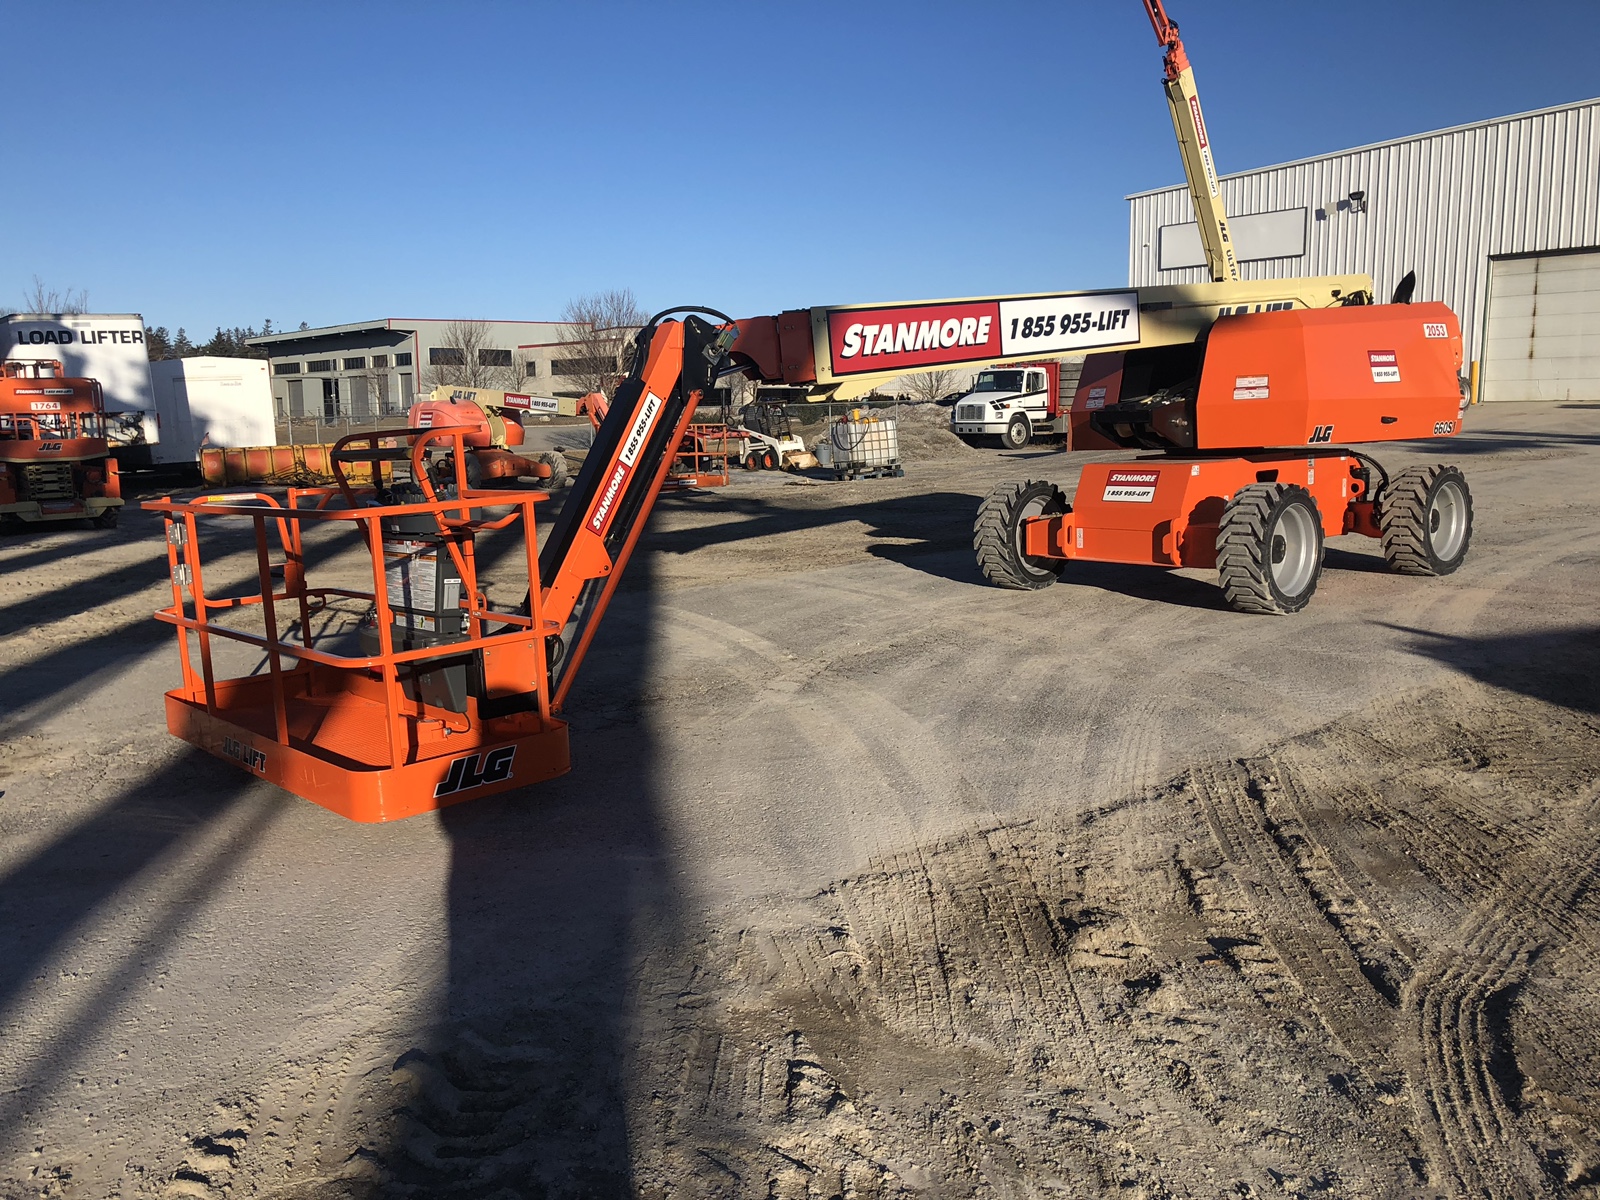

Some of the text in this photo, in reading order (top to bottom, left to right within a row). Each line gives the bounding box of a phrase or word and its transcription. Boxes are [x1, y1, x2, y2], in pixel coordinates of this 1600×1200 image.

[1218, 219, 1229, 243] JLG
[17, 330, 144, 345] LOAD LIFTER
[840, 315, 993, 359] STANMORE
[1059, 309, 1131, 335] 955-LIFT
[1426, 325, 1446, 336] 2053
[463, 391, 477, 400] LIFT
[1307, 425, 1334, 444] JLG
[38, 442, 62, 451] JLG
[592, 465, 626, 530] STANMORE
[636, 399, 656, 437] 955-LIFT
[1110, 473, 1157, 482] STANMORE
[222, 736, 267, 774] JLG LIFT
[433, 744, 518, 799] JLG
